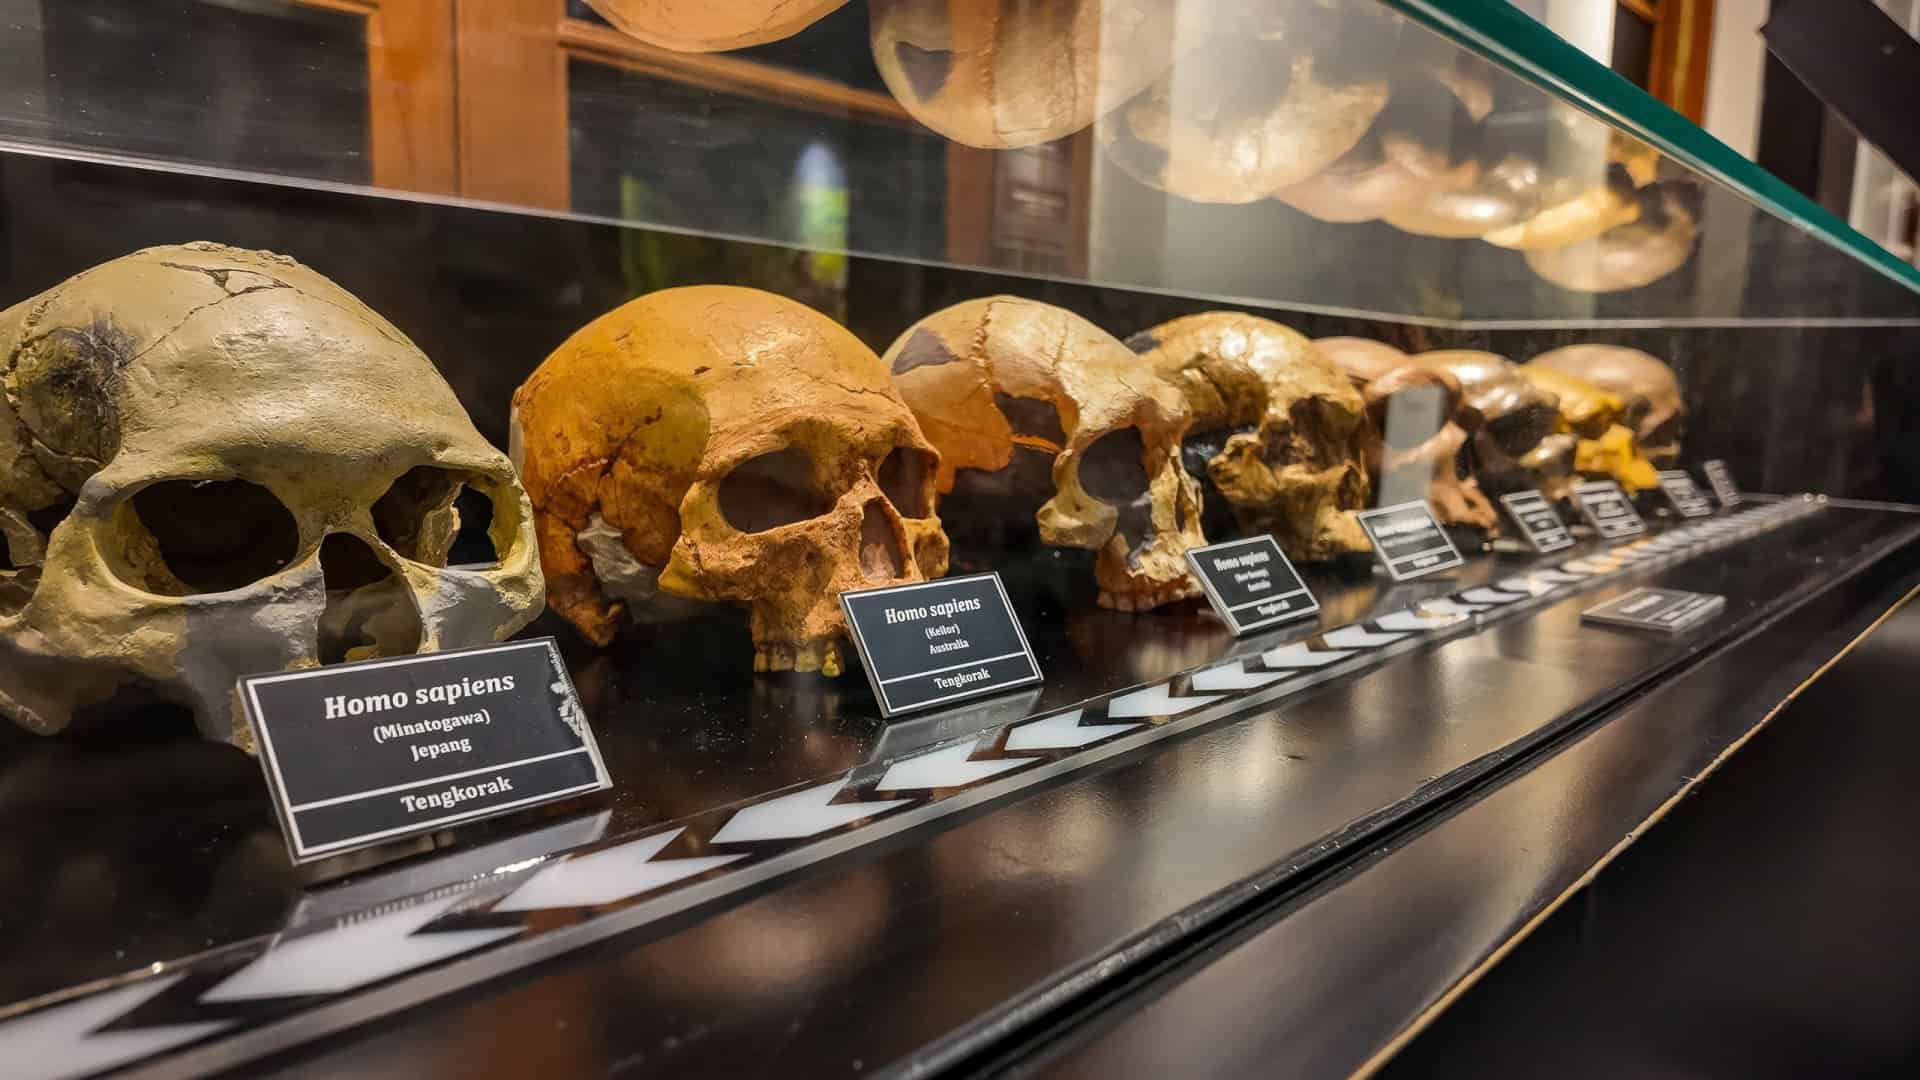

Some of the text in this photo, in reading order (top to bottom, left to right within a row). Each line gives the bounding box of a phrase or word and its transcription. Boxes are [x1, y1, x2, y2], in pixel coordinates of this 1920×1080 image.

[885, 598, 981, 624] Homo sapiens
[934, 668, 991, 689] Tengkorak
[324, 674, 515, 719] Homo sapiens
[373, 709, 491, 743] (Minatogawa)
[411, 737, 472, 762] Jepang
[400, 776, 513, 813] Tengkorak
